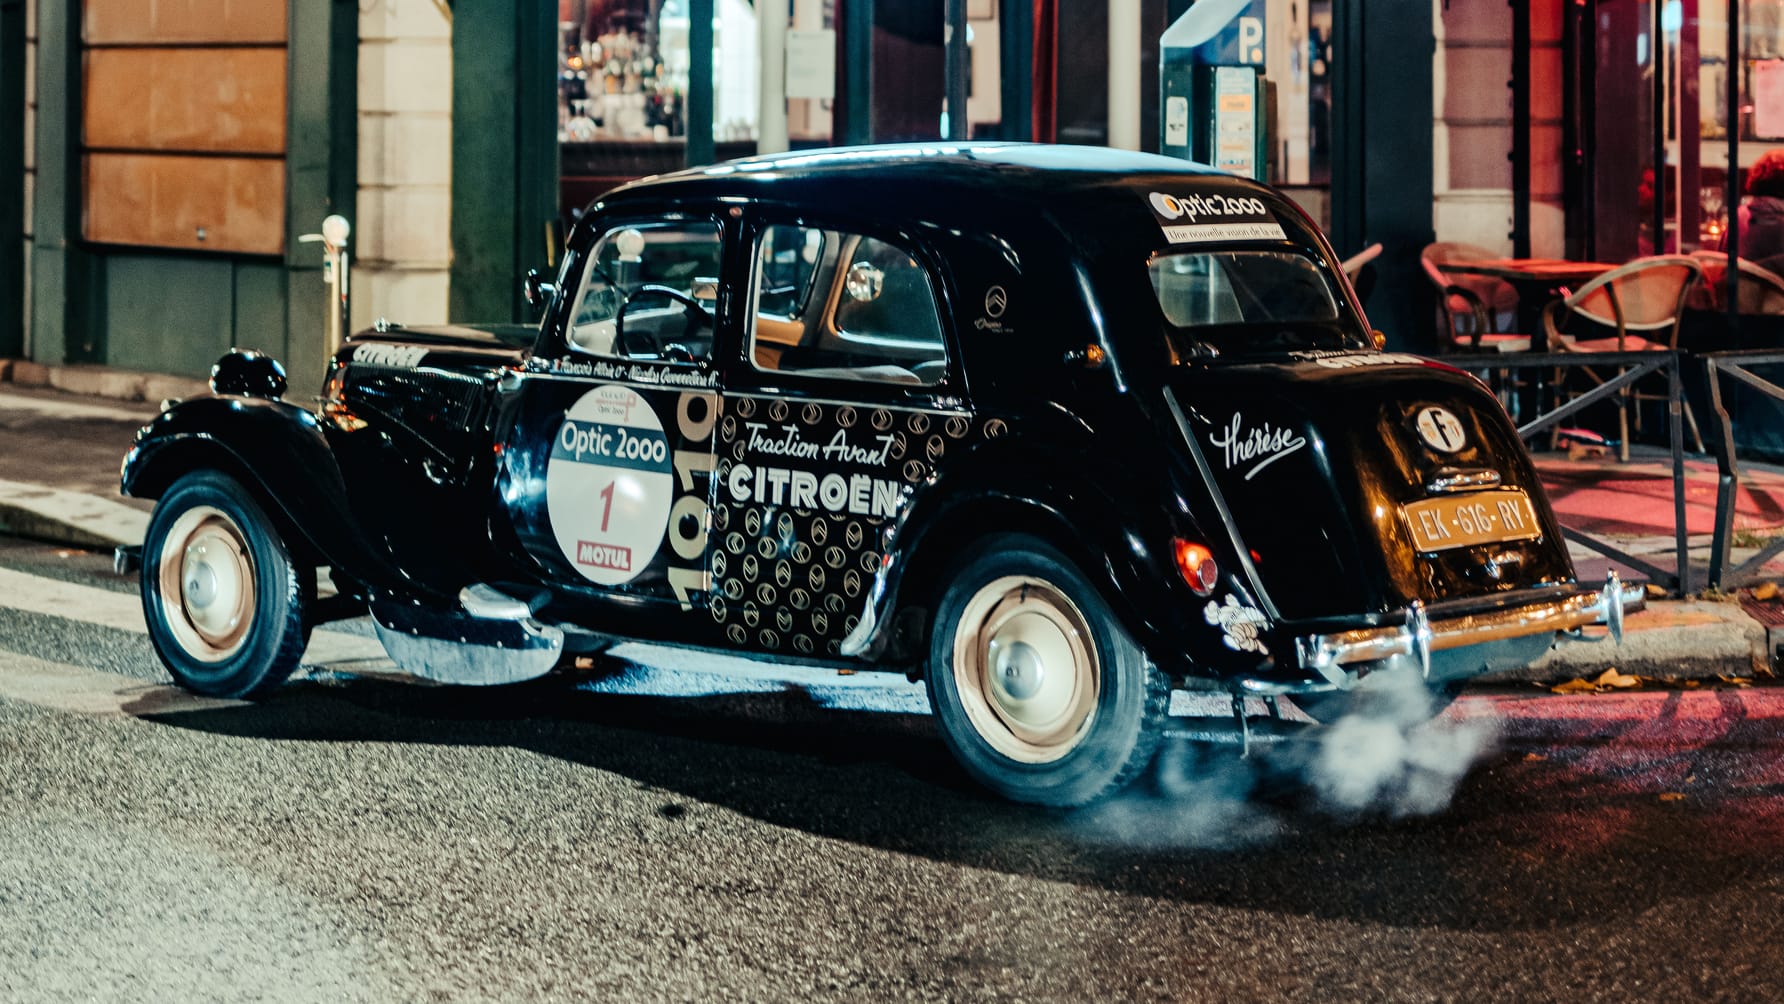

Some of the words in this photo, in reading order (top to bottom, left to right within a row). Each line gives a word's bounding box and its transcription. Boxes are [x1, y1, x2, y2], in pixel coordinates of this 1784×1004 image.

[1168, 229, 1188, 240] Une
[1189, 226, 1224, 240] nouvelle
[1226, 228, 1249, 238] vision
[1250, 226, 1260, 237] de
[562, 422, 612, 462] Optic
[616, 428, 667, 464] 2000
[745, 421, 820, 460] Traction
[822, 430, 895, 468] Avant
[1428, 410, 1452, 449] F
[600, 480, 616, 533] 1
[728, 463, 899, 519] CITROËN
[579, 544, 630, 570] MOTUL
